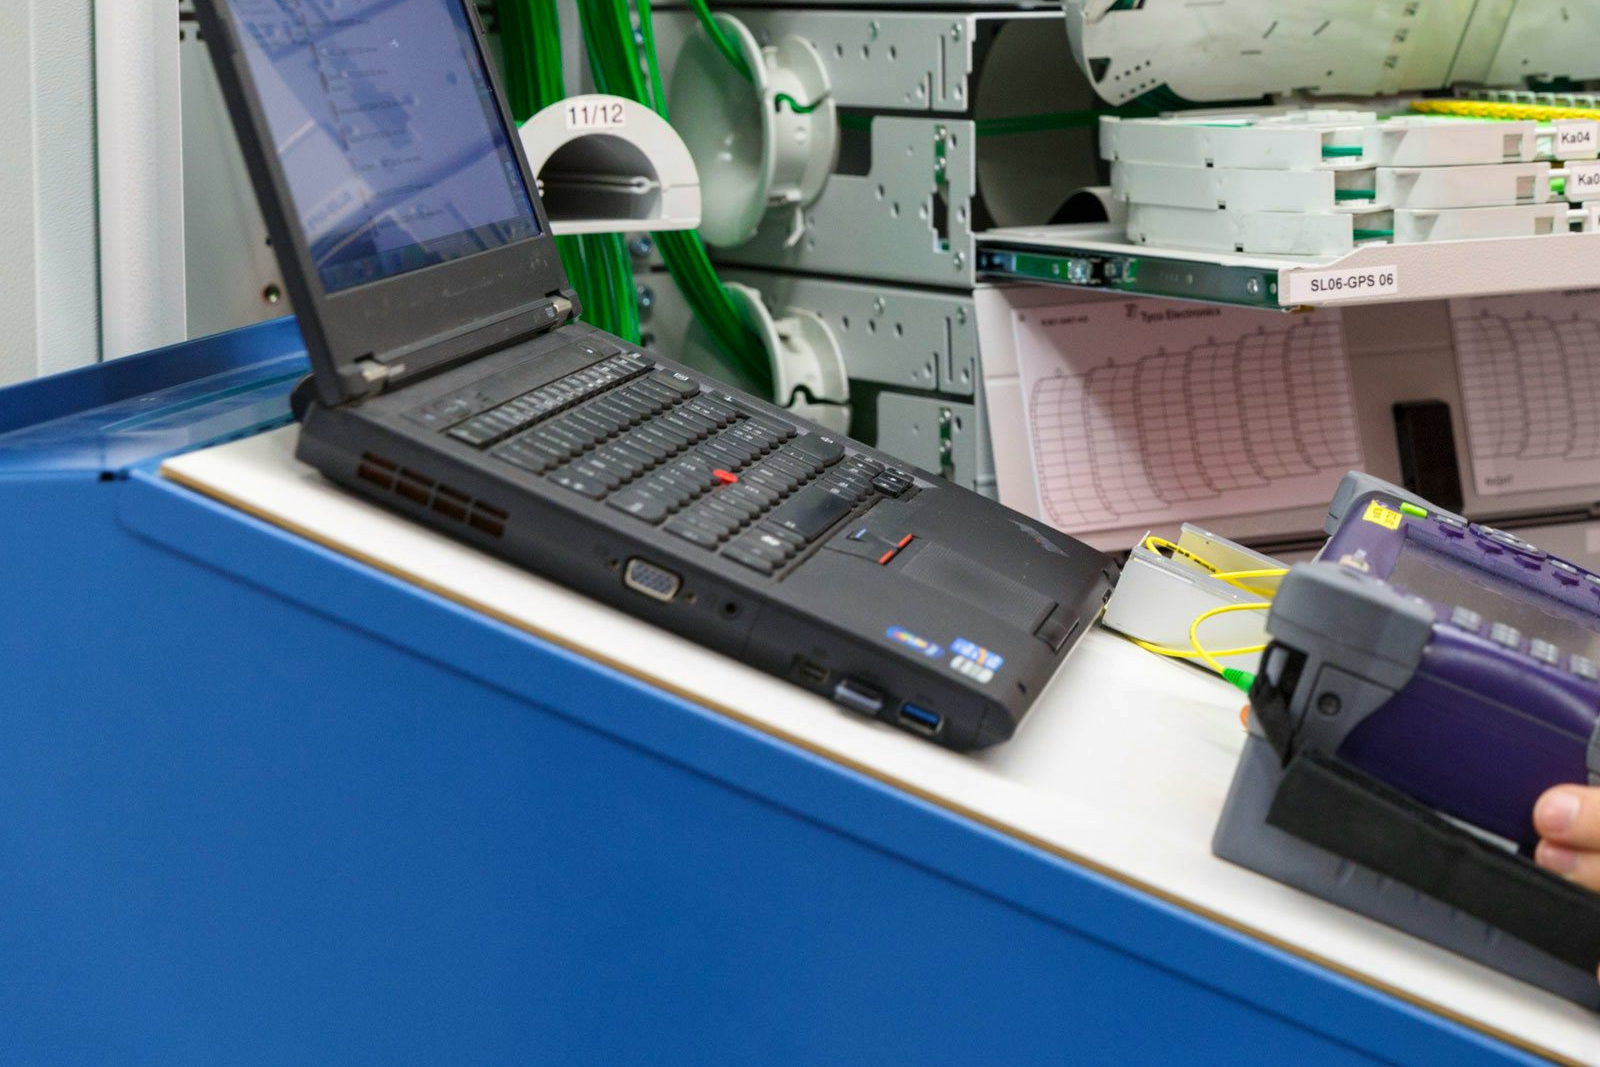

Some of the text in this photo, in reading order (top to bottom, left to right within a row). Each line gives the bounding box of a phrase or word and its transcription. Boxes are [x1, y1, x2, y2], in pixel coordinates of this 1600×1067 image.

[568, 103, 624, 125] 11/12
[1561, 131, 1590, 144] Ka04
[1310, 273, 1394, 292] SL06-GPS 06
[1140, 307, 1222, 323] Tyco Electronics
